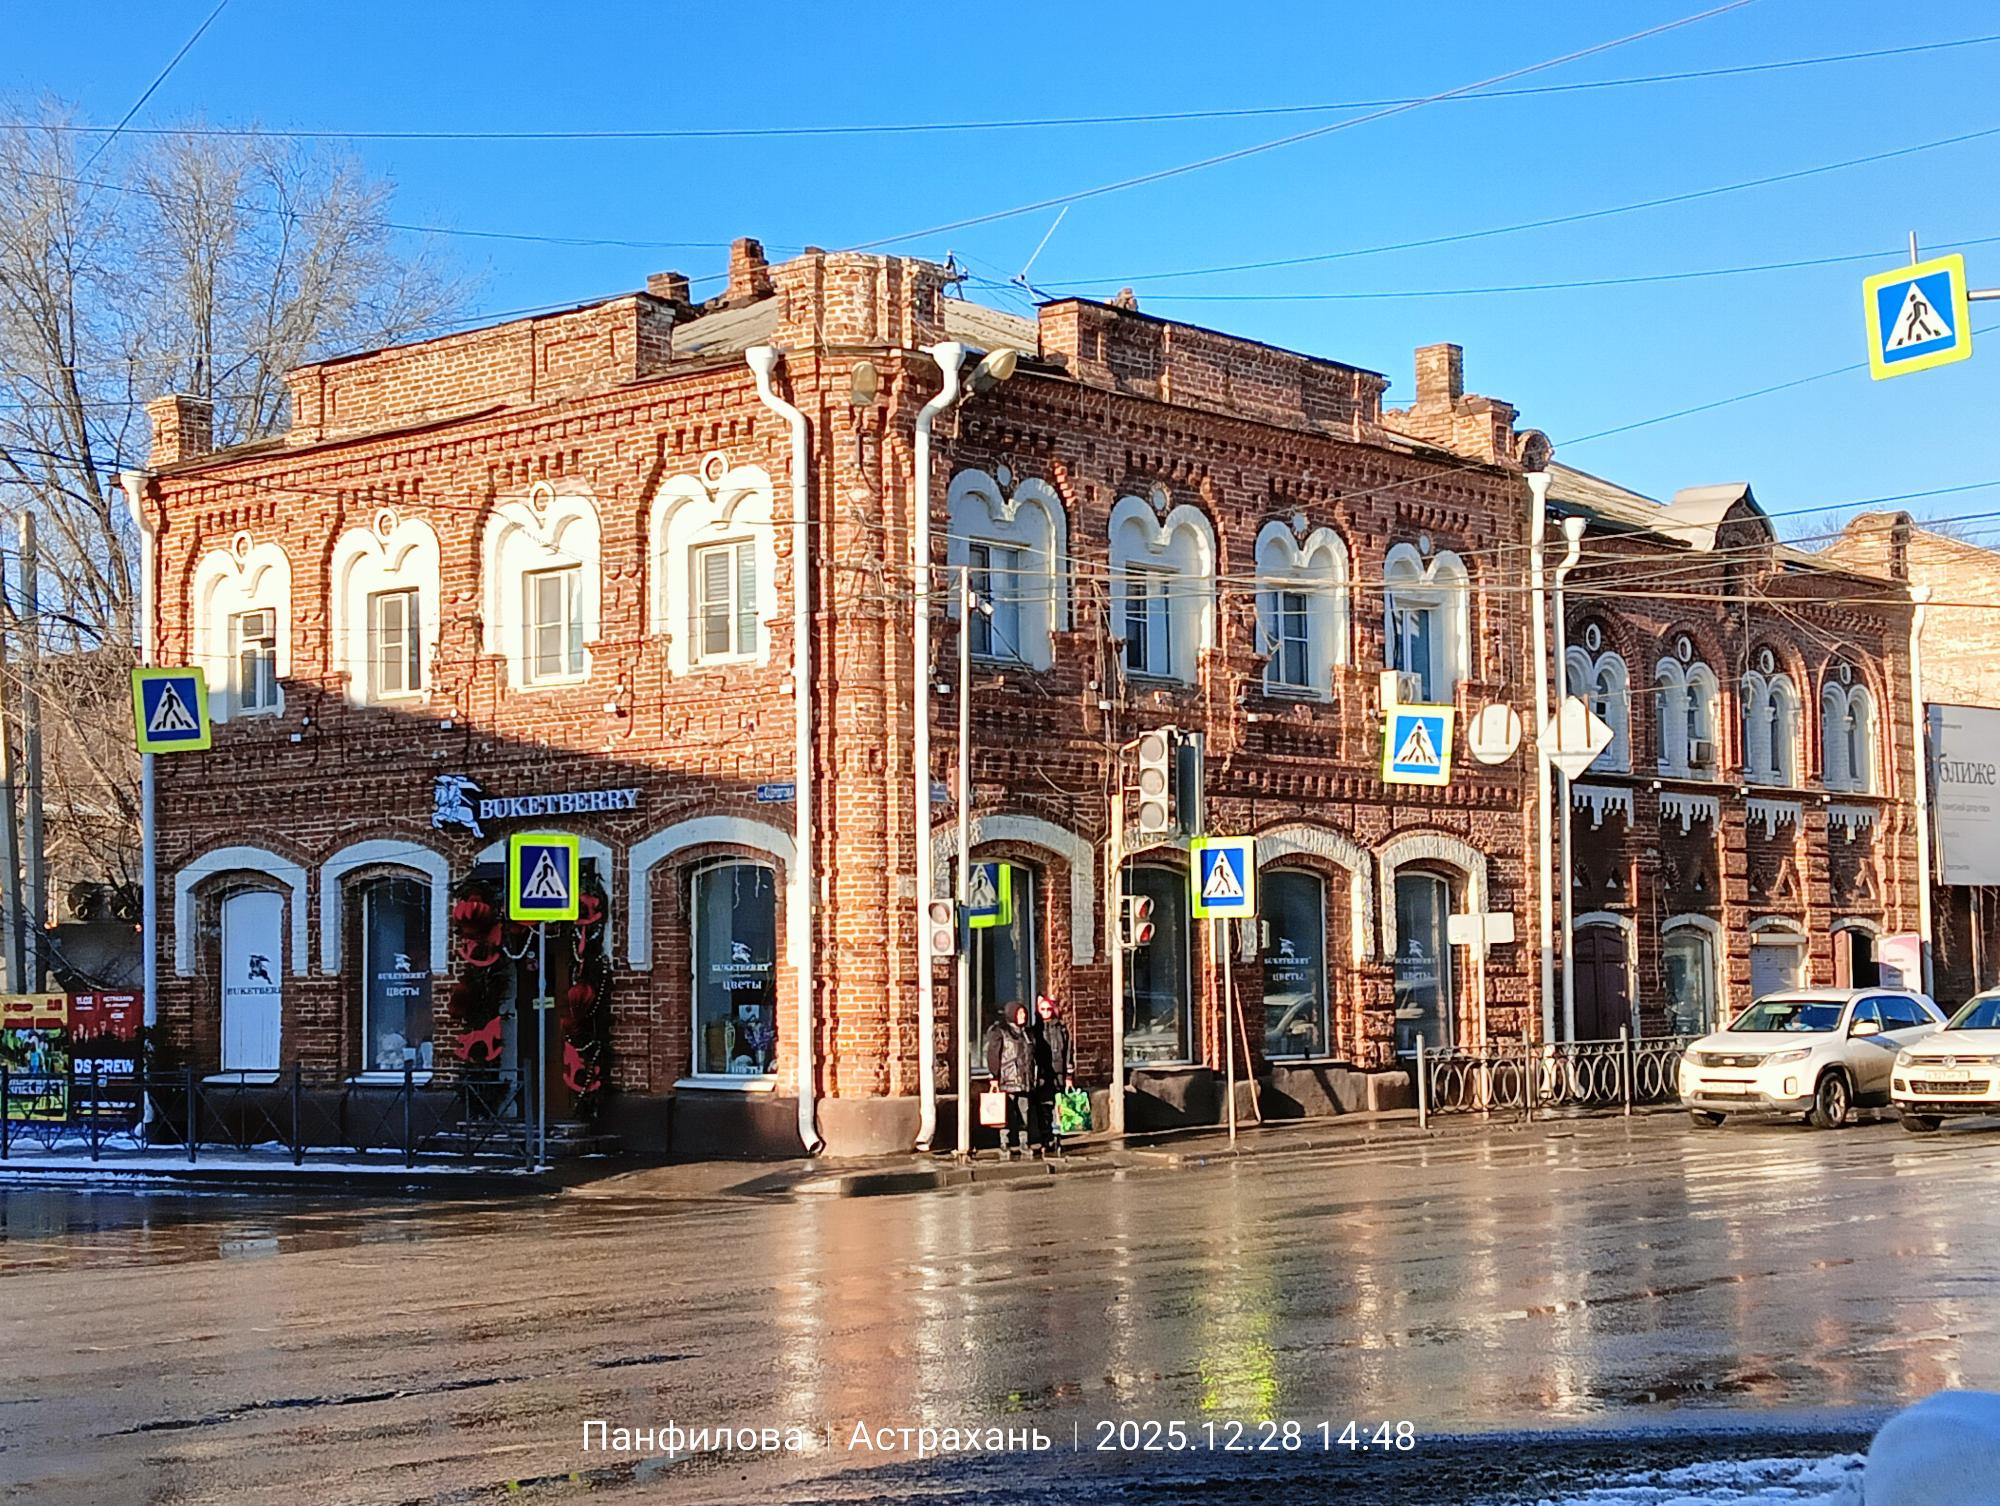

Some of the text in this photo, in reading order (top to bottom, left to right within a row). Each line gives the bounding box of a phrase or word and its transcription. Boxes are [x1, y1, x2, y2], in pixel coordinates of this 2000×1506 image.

[1938, 752, 1996, 786] ближе
[479, 787, 642, 819] BUKETBERRY
[74, 1059, 92, 1074] DS
